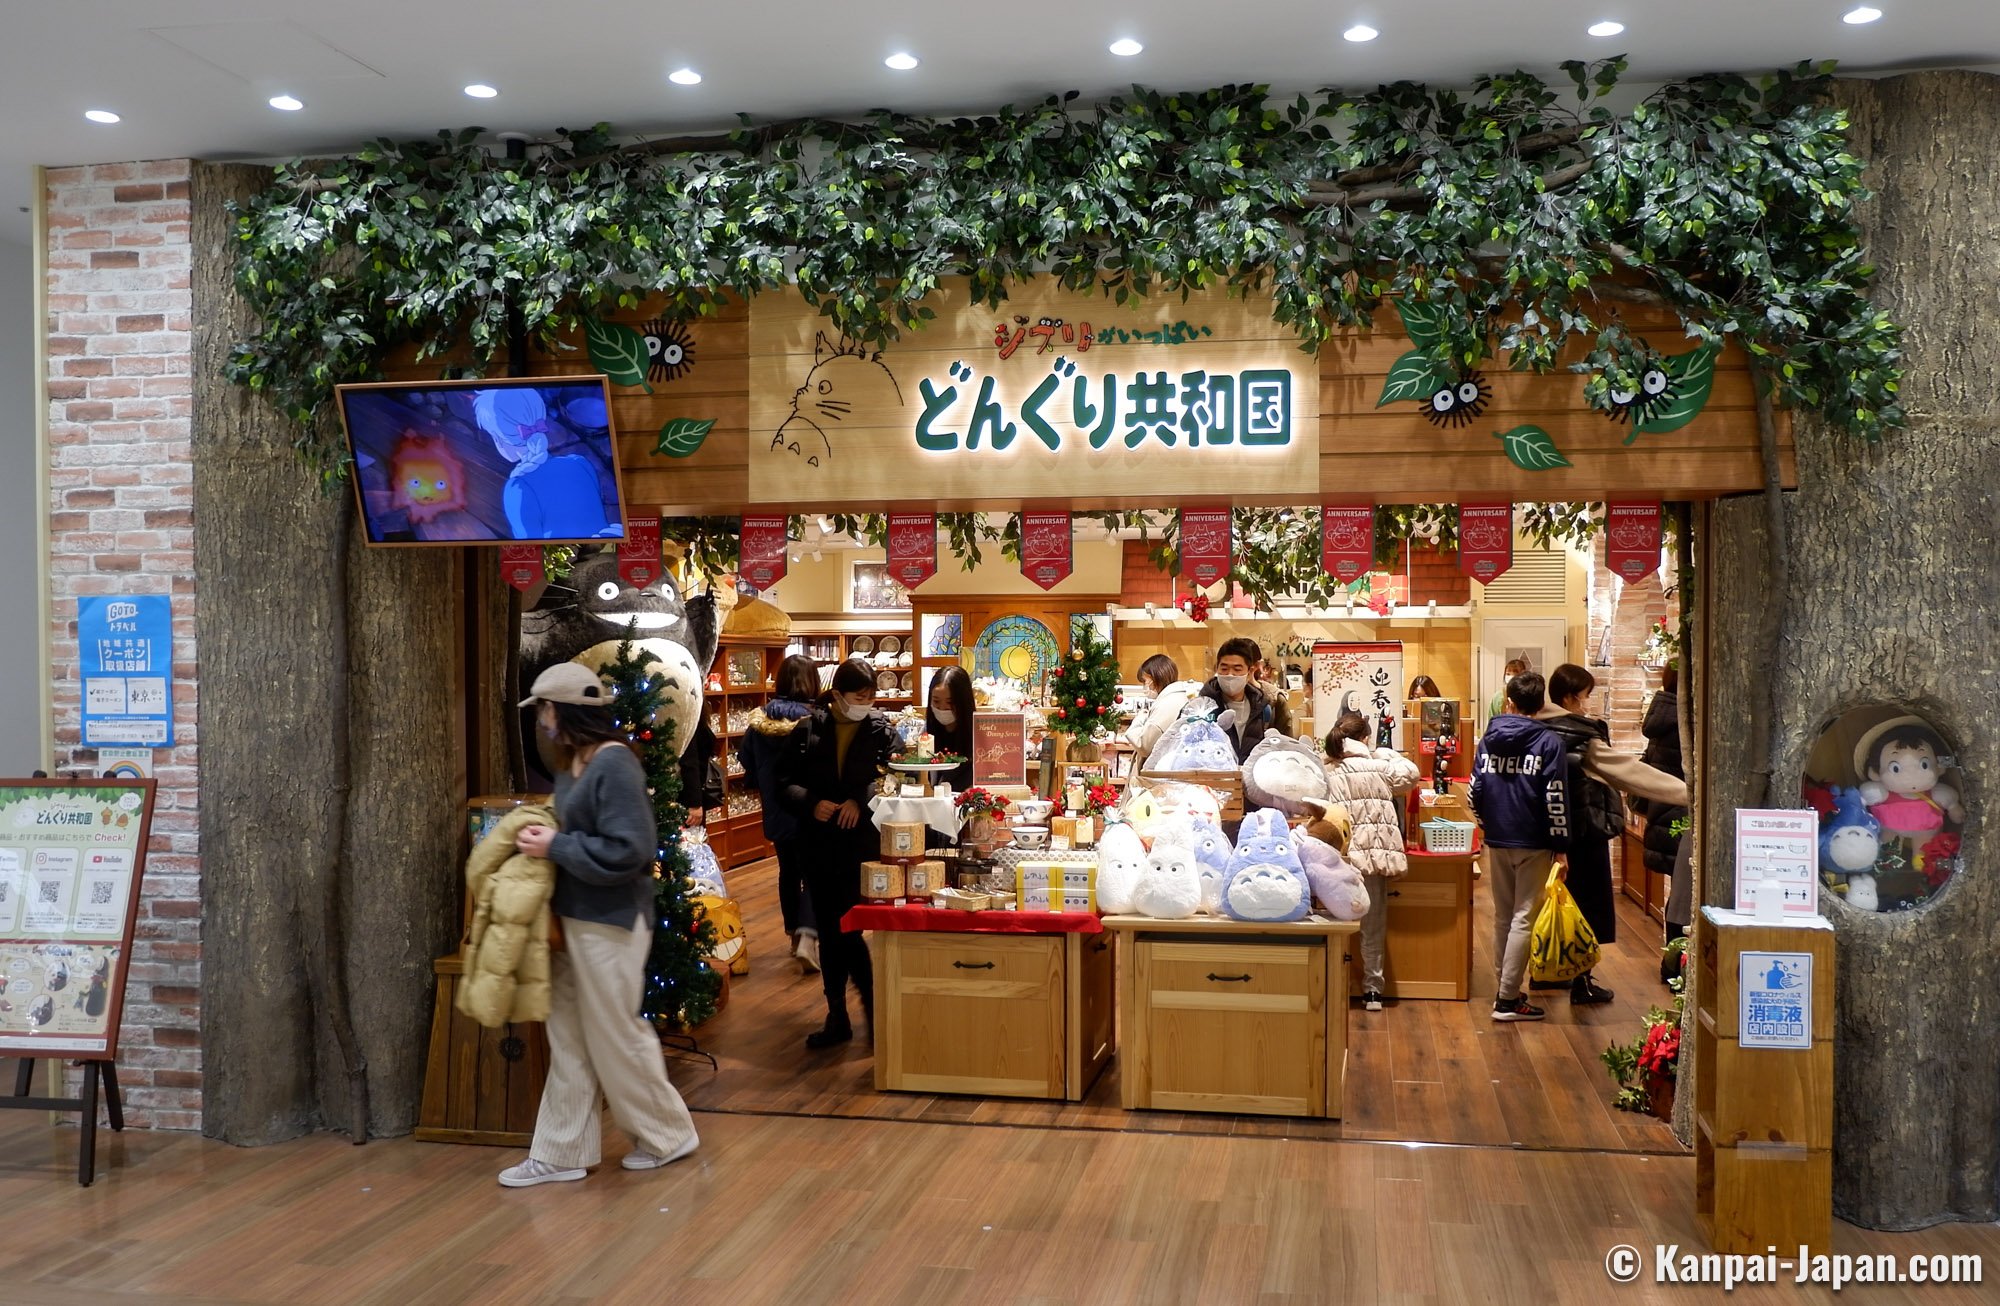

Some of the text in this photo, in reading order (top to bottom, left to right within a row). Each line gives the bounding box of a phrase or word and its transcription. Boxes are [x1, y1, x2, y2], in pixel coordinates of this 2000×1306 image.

[995, 315, 1212, 360] ジブリがいっぱい
[915, 355, 1292, 452] どんぐり共和国
[1326, 510, 1370, 518] ANNIVERSARY
[1463, 509, 1507, 517] ANNIVERSARY
[1612, 508, 1657, 516] ANNIVERSARY
[1184, 515, 1227, 523] ANNIVERSARY
[110, 622, 136, 632] トラベル
[104, 648, 145, 659] クーポン
[105, 660, 146, 672] 取扱店舗
[1369, 667, 1391, 710] 迎春
[1480, 754, 1543, 776] DEVELOP
[1546, 780, 1568, 837] SCOPE
[36, 810, 93, 825] どんぐり共和国
[94, 833, 126, 842] Check!
[1748, 1004, 1802, 1022] 消毒液
